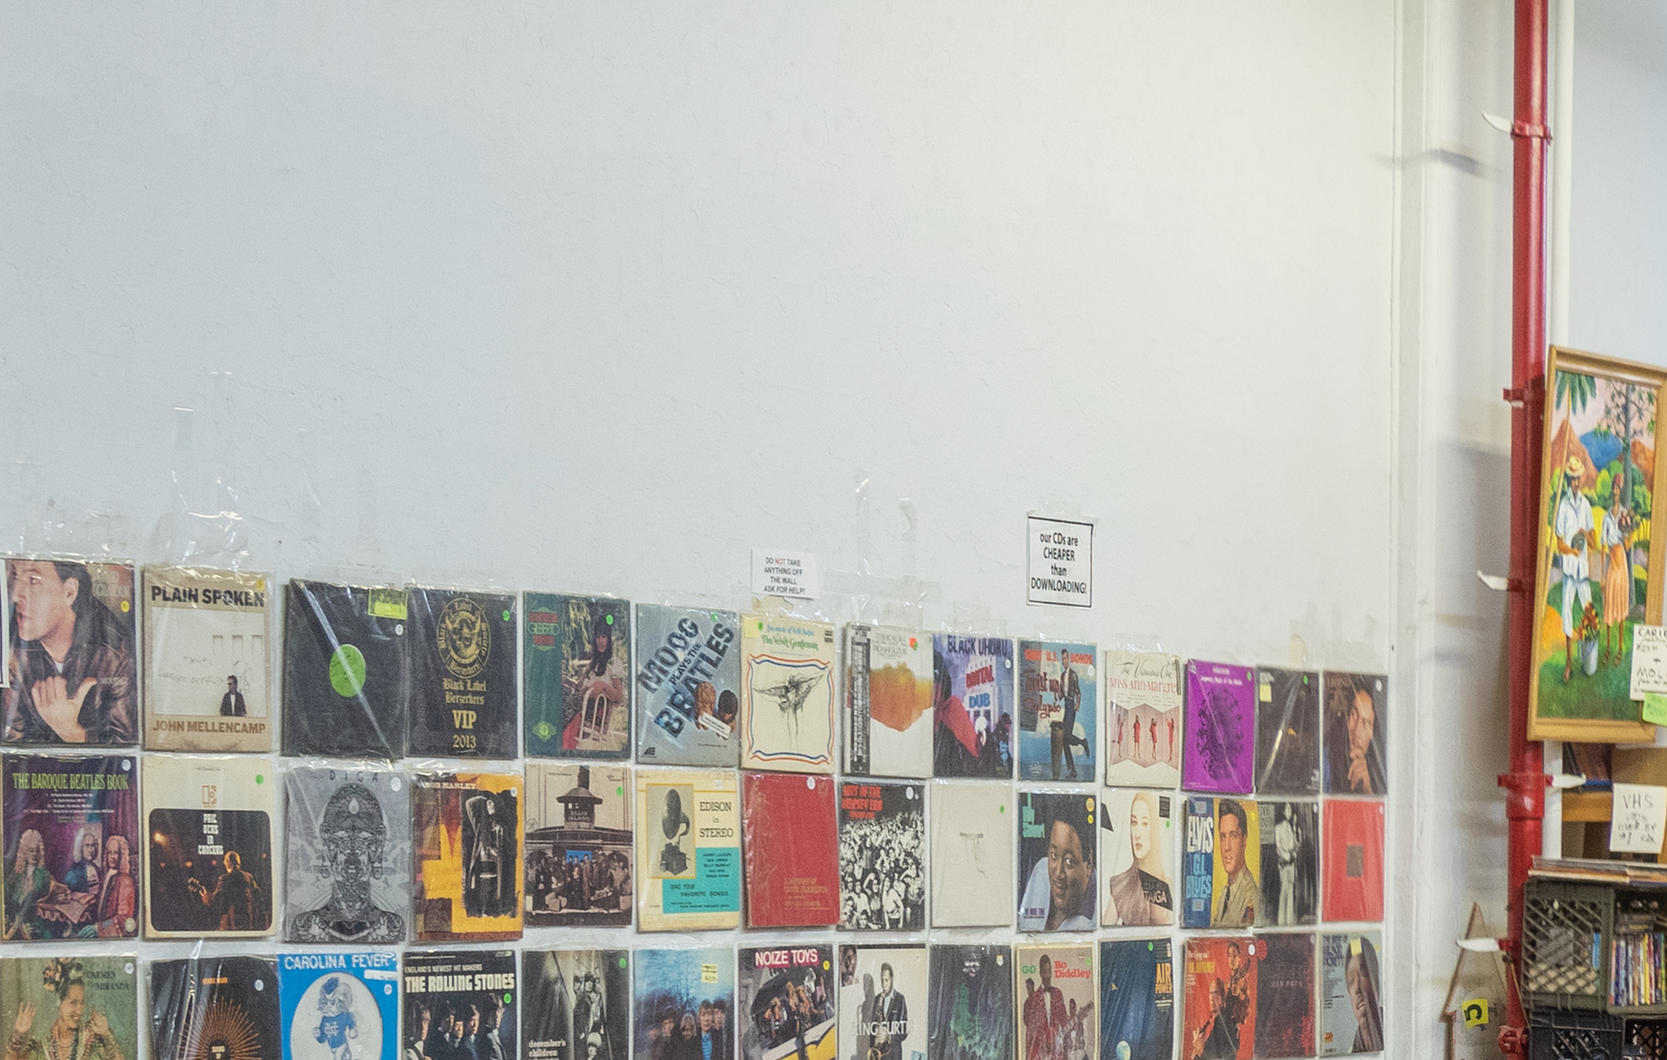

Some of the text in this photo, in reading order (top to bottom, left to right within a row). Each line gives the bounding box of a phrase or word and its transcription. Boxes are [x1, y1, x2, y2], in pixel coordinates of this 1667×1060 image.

[1040, 532, 1078, 546] our CDs are
[1043, 547, 1075, 562] CHEAPER
[787, 559, 801, 567] TAKE
[1051, 564, 1067, 576] than
[764, 567, 790, 575] ANYTHING
[770, 576, 797, 585] THE WALL
[1031, 578, 1087, 594] DOWNLOADING!
[152, 586, 264, 607] PLAIN SPOKEN
[789, 587, 805, 595] HELP!
[948, 635, 981, 654] BLACK
[638, 617, 699, 694] MOOG
[654, 623, 735, 737] BEATLES
[969, 693, 990, 708] DUB
[153, 720, 265, 734] JOHN MELLENCAMP
[453, 710, 476, 729] VIP
[453, 735, 476, 749] 2013
[13, 773, 128, 791] THE BAROQUE BEATLES BOOK
[700, 801, 731, 813] EDISON
[1623, 793, 1654, 809] VHS
[700, 827, 734, 839] STEREO
[1187, 816, 1213, 853] ELVIS
[1186, 875, 1212, 899] BLUES
[284, 954, 389, 970] CAROLINA FEVER
[756, 949, 819, 966] NOIZE TOYS
[1055, 961, 1067, 969] Bo
[1022, 965, 1037, 975] GO
[1055, 969, 1091, 980] Diddley
[1156, 963, 1172, 984] AIR
[405, 973, 514, 992] THE ROLLING STONES
